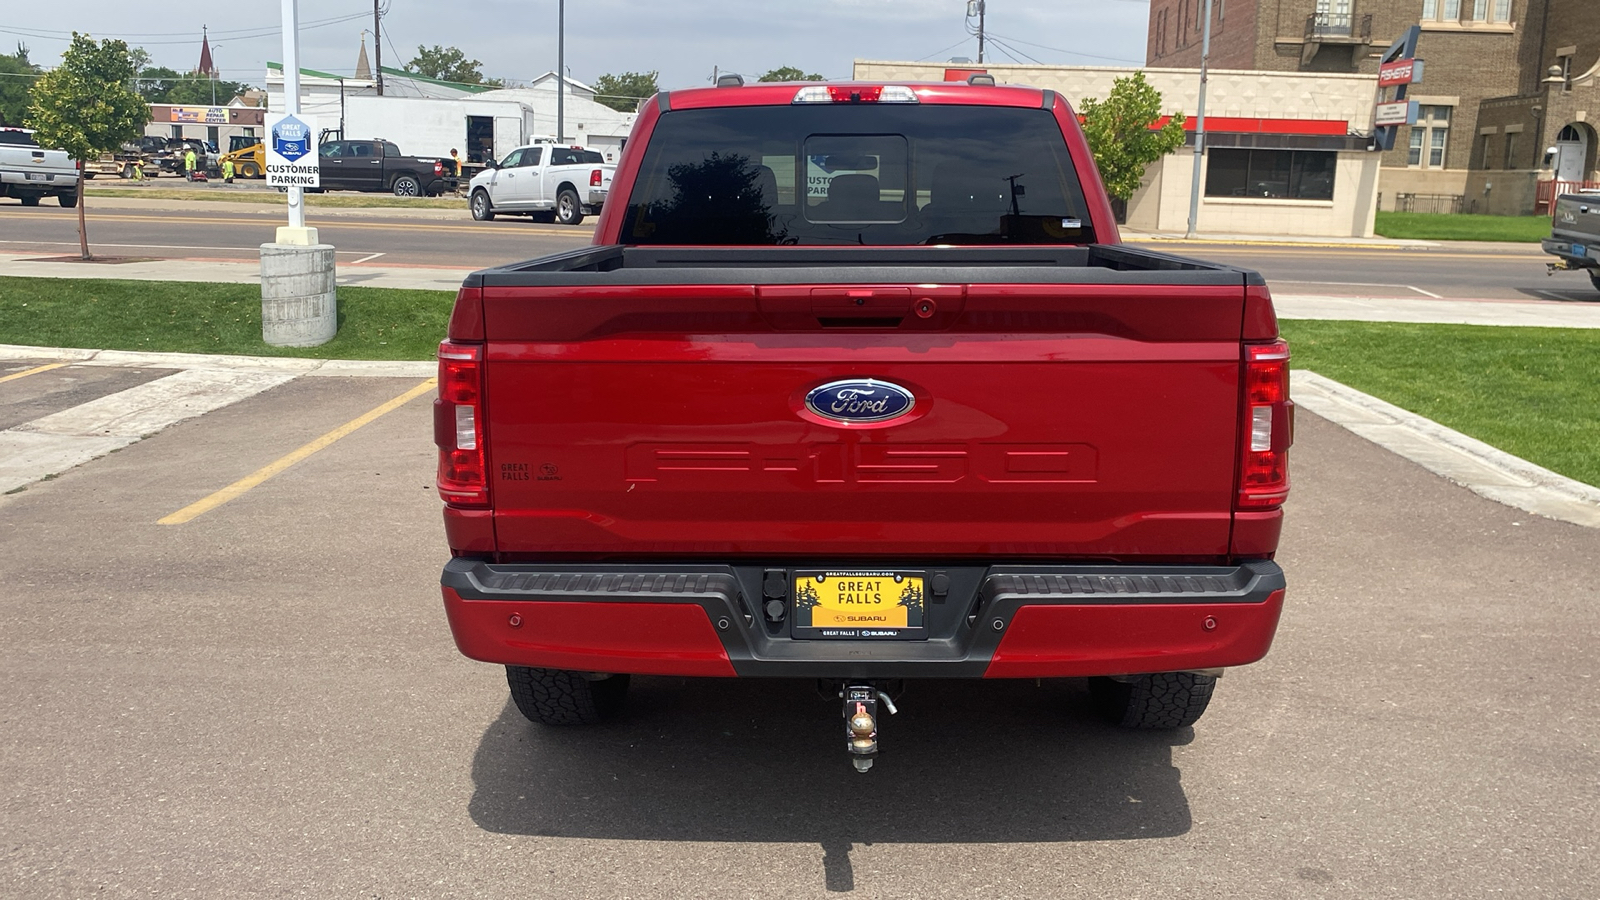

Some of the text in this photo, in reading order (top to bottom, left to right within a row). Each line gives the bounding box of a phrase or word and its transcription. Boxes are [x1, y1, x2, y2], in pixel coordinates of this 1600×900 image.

[266, 165, 319, 174] CUSTOMER
[271, 175, 314, 184] PARKING
[831, 388, 889, 413] Ford
[501, 463, 529, 472] GREAT
[502, 472, 530, 481] FALLS
[838, 582, 882, 592] GREAT
[838, 593, 882, 604] FALLS
